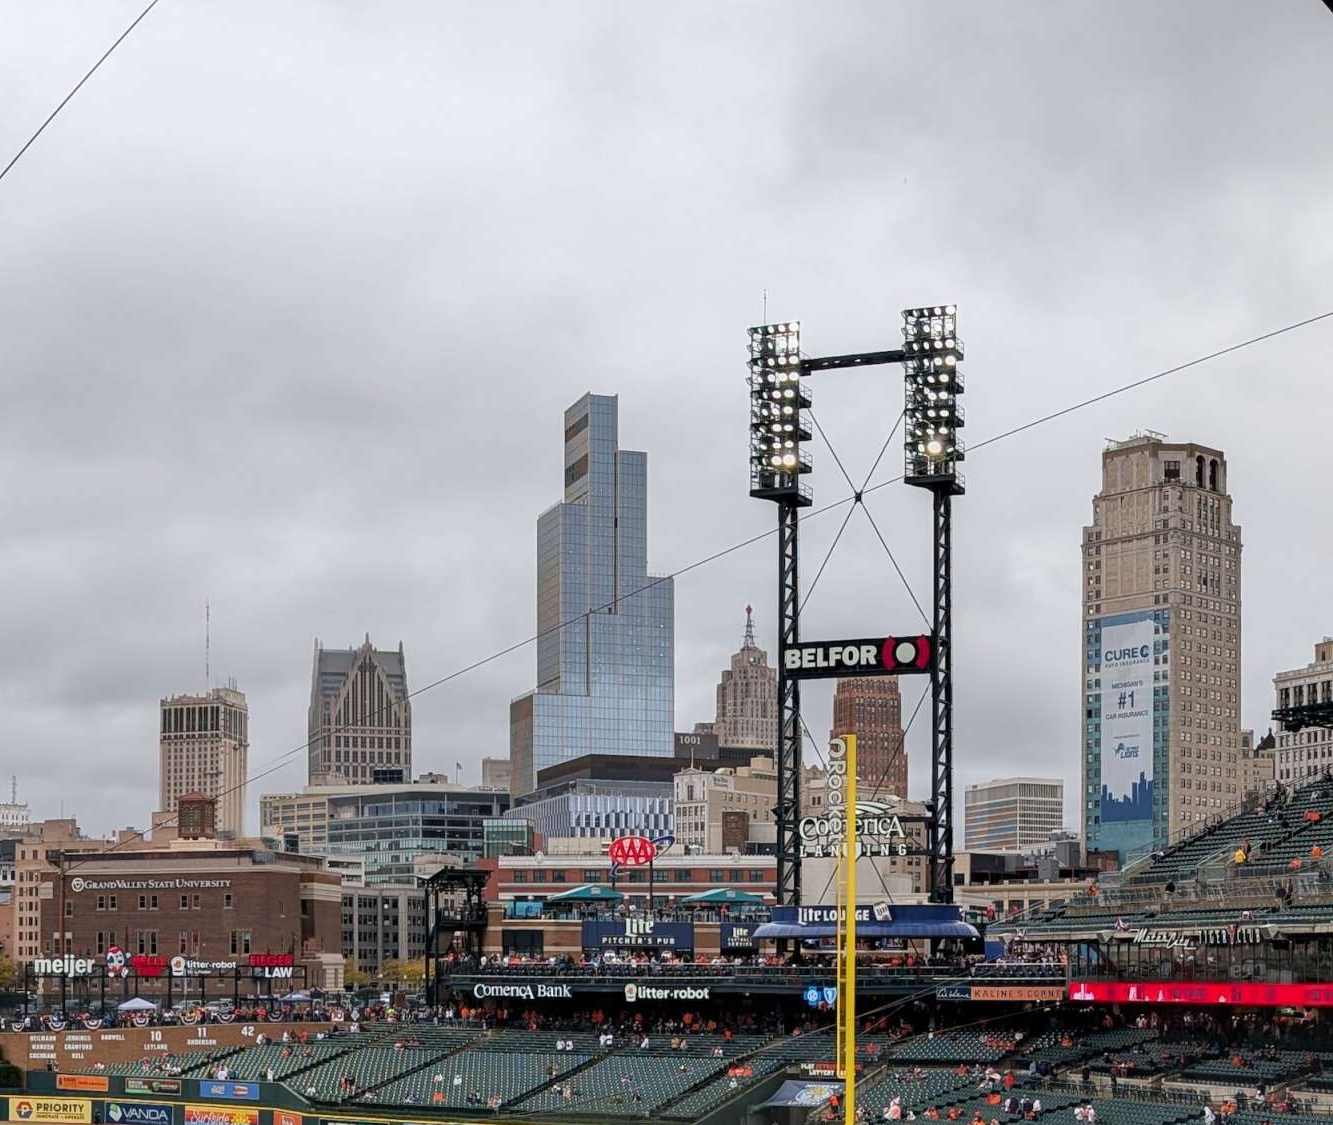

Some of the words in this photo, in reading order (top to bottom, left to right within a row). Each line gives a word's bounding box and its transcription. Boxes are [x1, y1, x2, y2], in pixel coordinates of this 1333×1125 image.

[784, 645, 878, 669] BELFOR
[1104, 648, 1138, 662] CURE
[1118, 690, 1134, 710] #1
[1117, 710, 1149, 720] INSURANCE
[679, 736, 700, 745] 1001
[611, 837, 654, 865] AAA
[800, 843, 907, 858] LANING
[84, 880, 117, 889] GRAND
[116, 880, 148, 889] VALLEY
[148, 880, 175, 889] STATE
[175, 879, 231, 888] UNIVERSITY
[797, 907, 821, 926] Lite
[823, 909, 870, 922] LOUGE
[625, 918, 654, 937] Lite
[733, 927, 748, 938] Lite
[602, 937, 652, 945] PITCHER'S
[657, 937, 675, 945] PUB
[1236, 928, 1261, 943] CLUB
[34, 954, 95, 977] meijer
[265, 967, 293, 978] LAW
[537, 984, 572, 998] Bank
[150, 1031, 162, 1041] 10
[197, 1027, 207, 1038] 11
[241, 1026, 255, 1036] 42
[36, 1103, 85, 1113] PRIORITY
[122, 1107, 169, 1121] VANDA
[191, 1110, 230, 1125] Surfside
